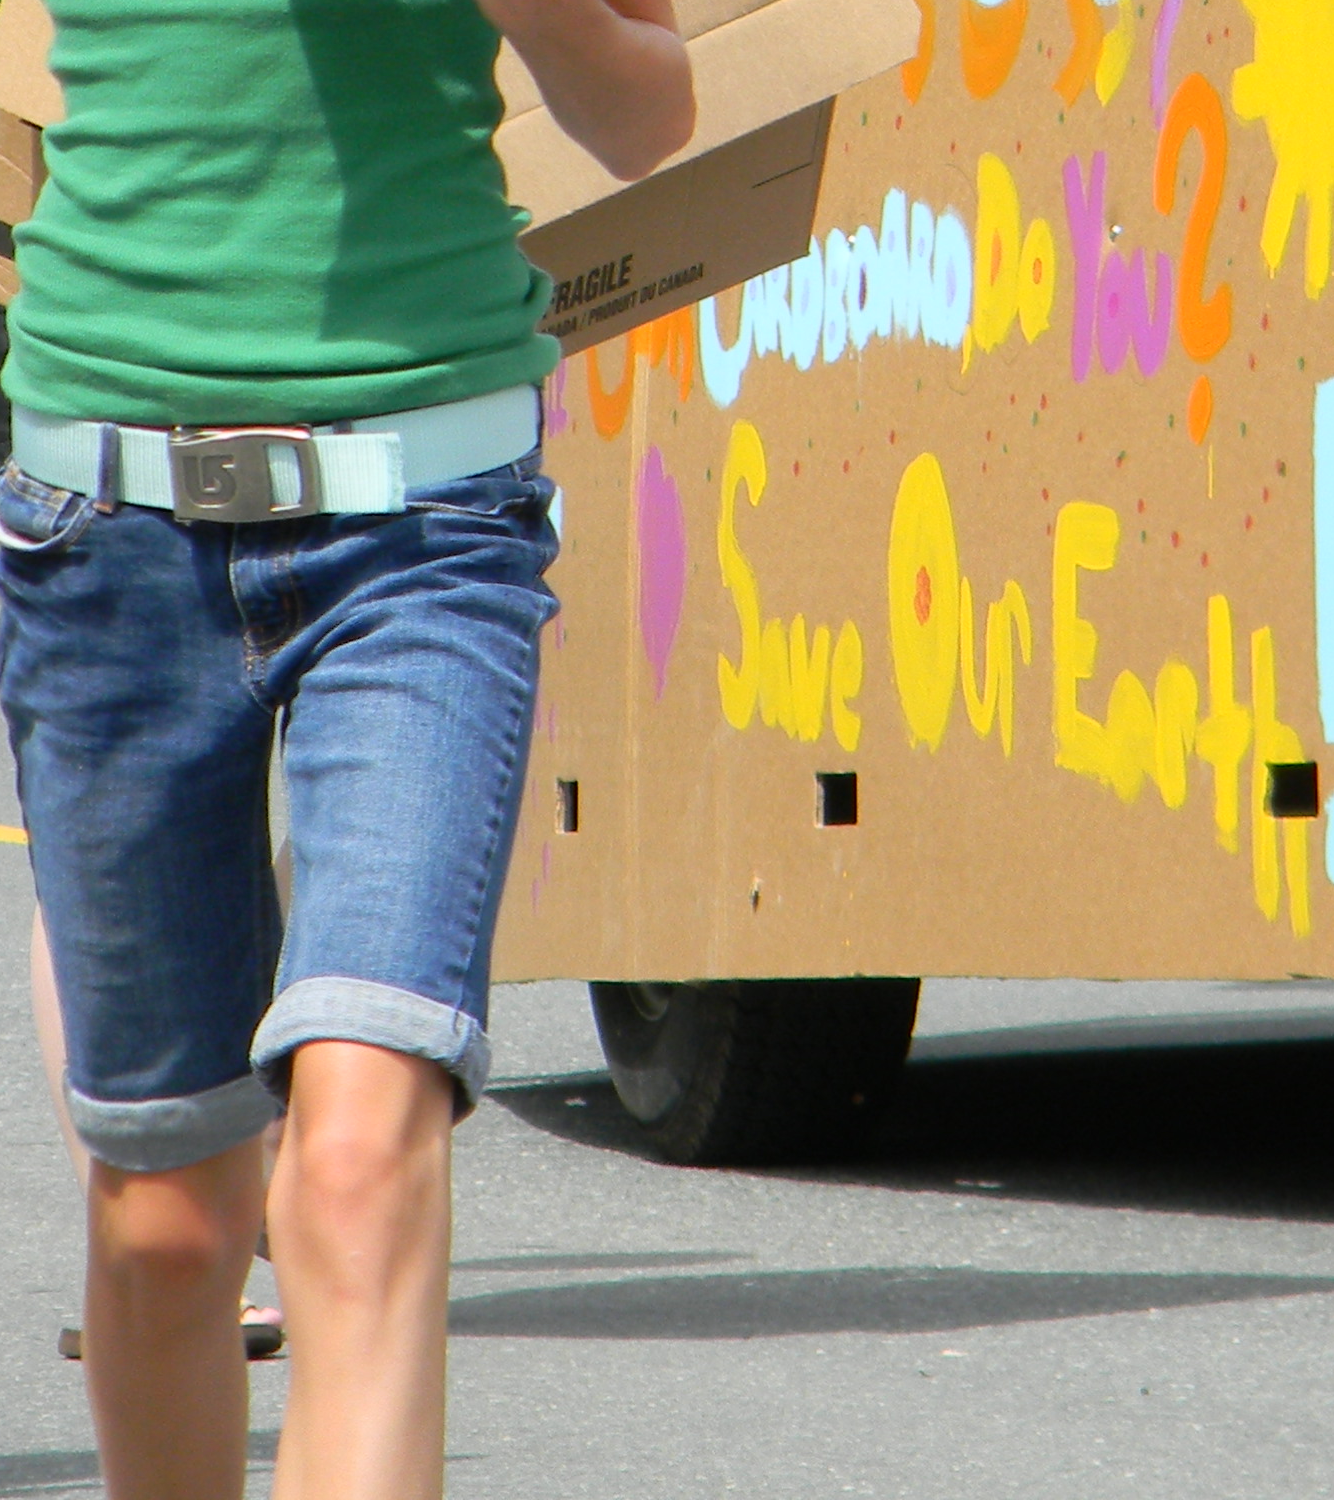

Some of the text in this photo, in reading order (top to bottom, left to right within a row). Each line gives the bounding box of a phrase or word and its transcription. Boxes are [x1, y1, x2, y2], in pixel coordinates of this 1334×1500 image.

[587, 290, 638, 327] PRODUIT
[657, 262, 705, 297] CANADA
[717, 418, 863, 753] Save
[887, 451, 1033, 760] Our
